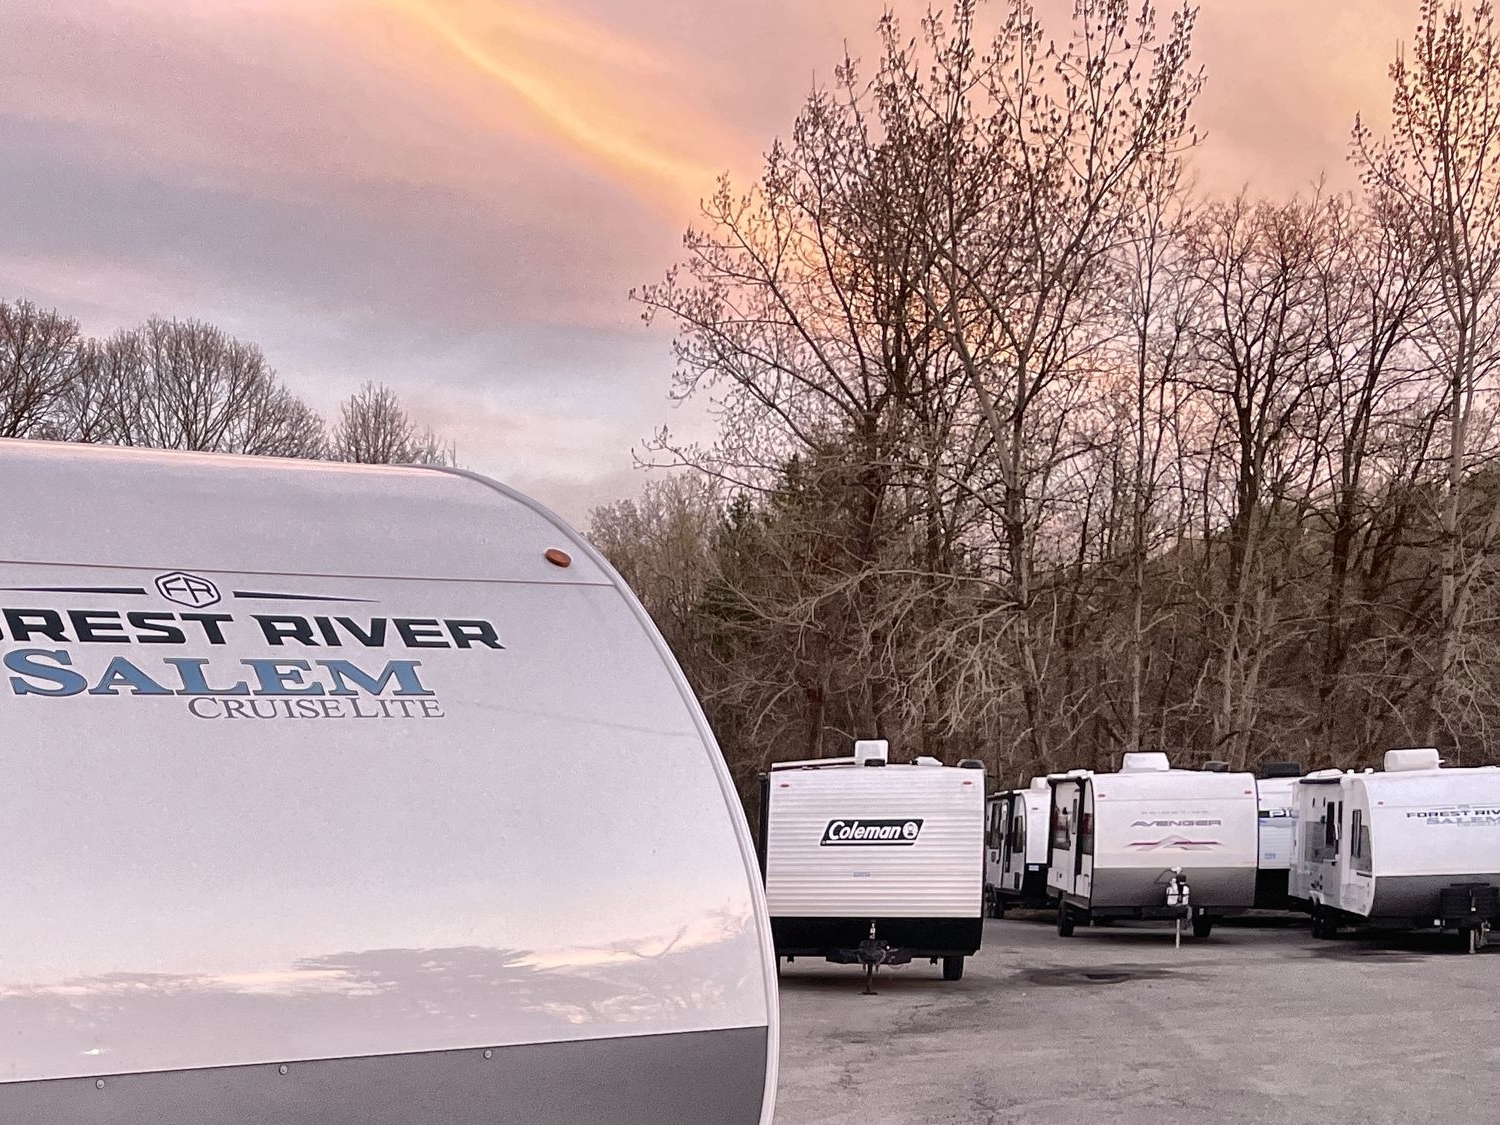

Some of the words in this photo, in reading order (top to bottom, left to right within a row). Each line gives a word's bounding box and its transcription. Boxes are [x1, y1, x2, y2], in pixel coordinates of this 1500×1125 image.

[250, 614, 506, 650] RIVER
[3, 648, 436, 697] SALEM
[1130, 819, 1222, 827] AVENGER
[1406, 810, 1471, 818] FOREST
[828, 820, 902, 840] Coleman
